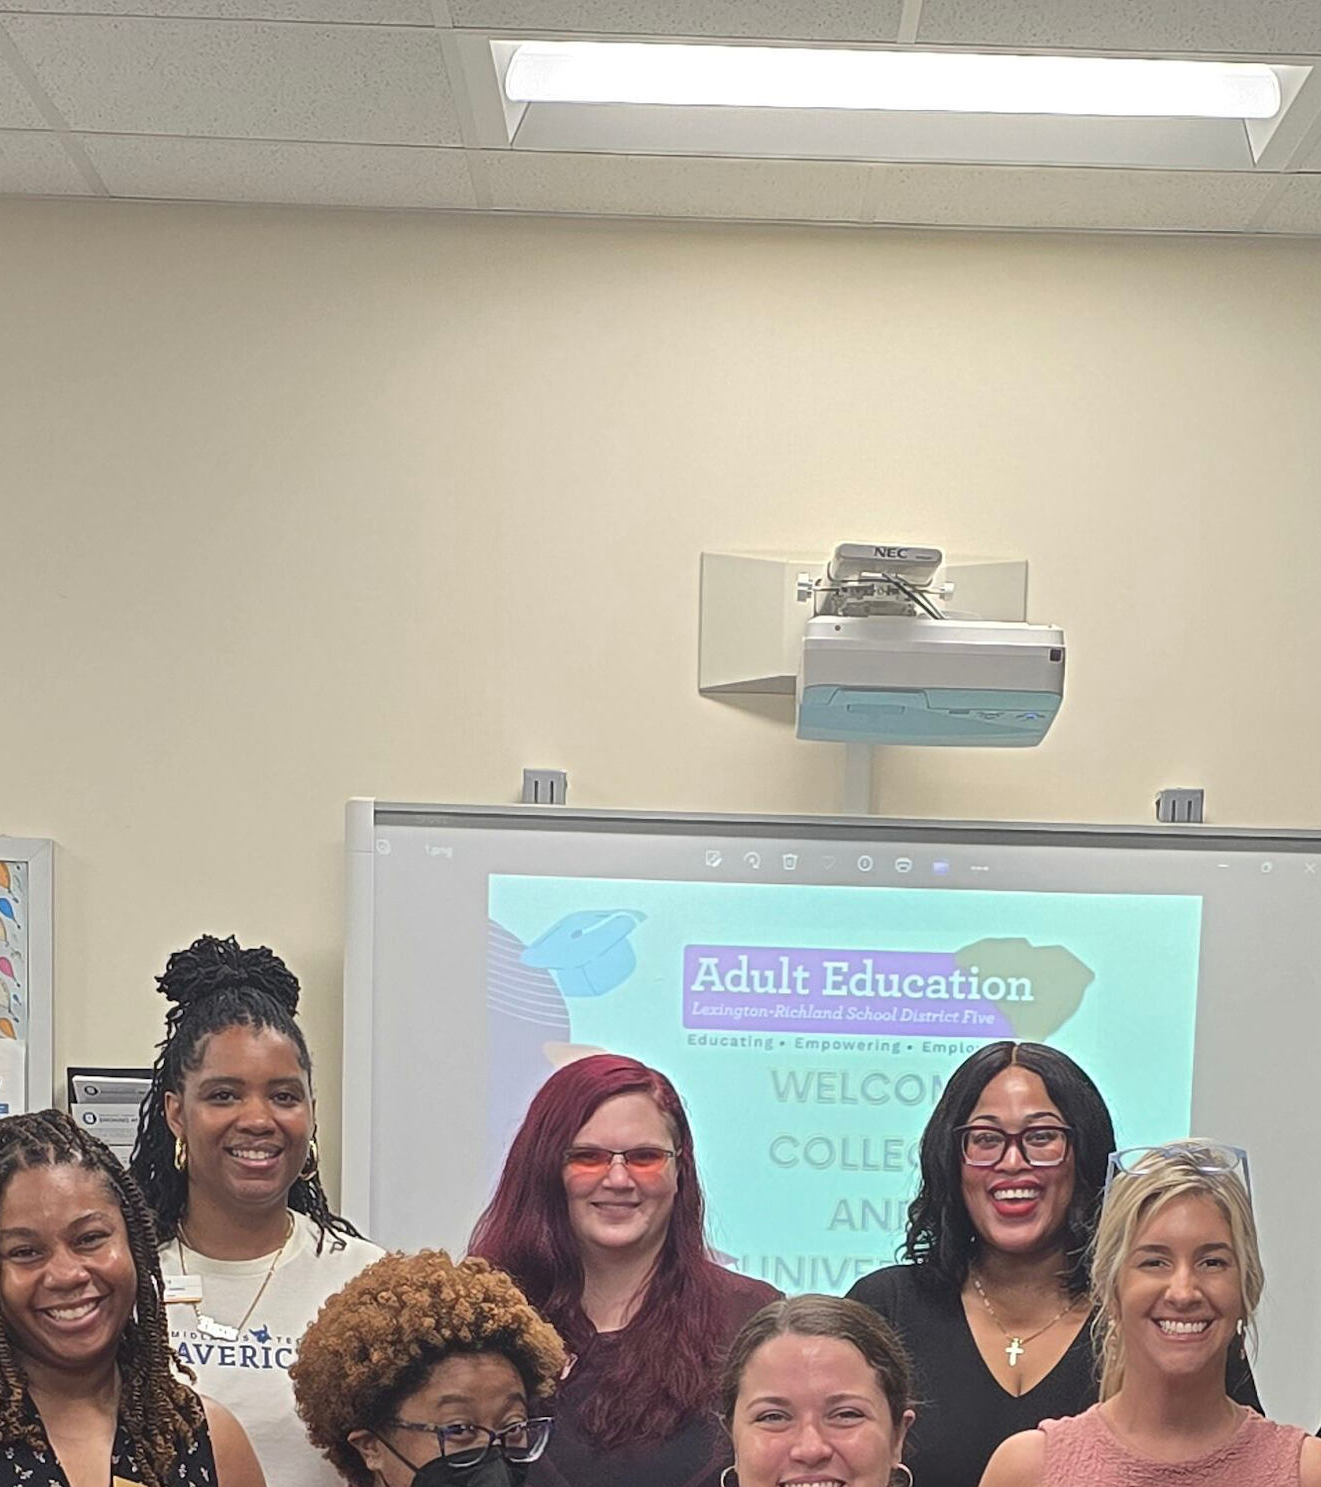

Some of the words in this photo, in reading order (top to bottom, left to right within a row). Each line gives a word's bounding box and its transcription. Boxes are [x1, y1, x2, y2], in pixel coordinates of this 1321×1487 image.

[874, 547, 908, 559] NEC
[424, 844, 453, 859] 1.png
[691, 955, 810, 995] Adult
[822, 960, 1034, 1001] Education
[692, 1002, 843, 1021] Lexington-Richland
[846, 1006, 897, 1022] School
[900, 1008, 959, 1024] District
[961, 1010, 995, 1025] Five
[687, 1034, 773, 1051] Educating
[795, 1037, 901, 1054] Empowering
[171, 1330, 249, 1343] MIDLS
